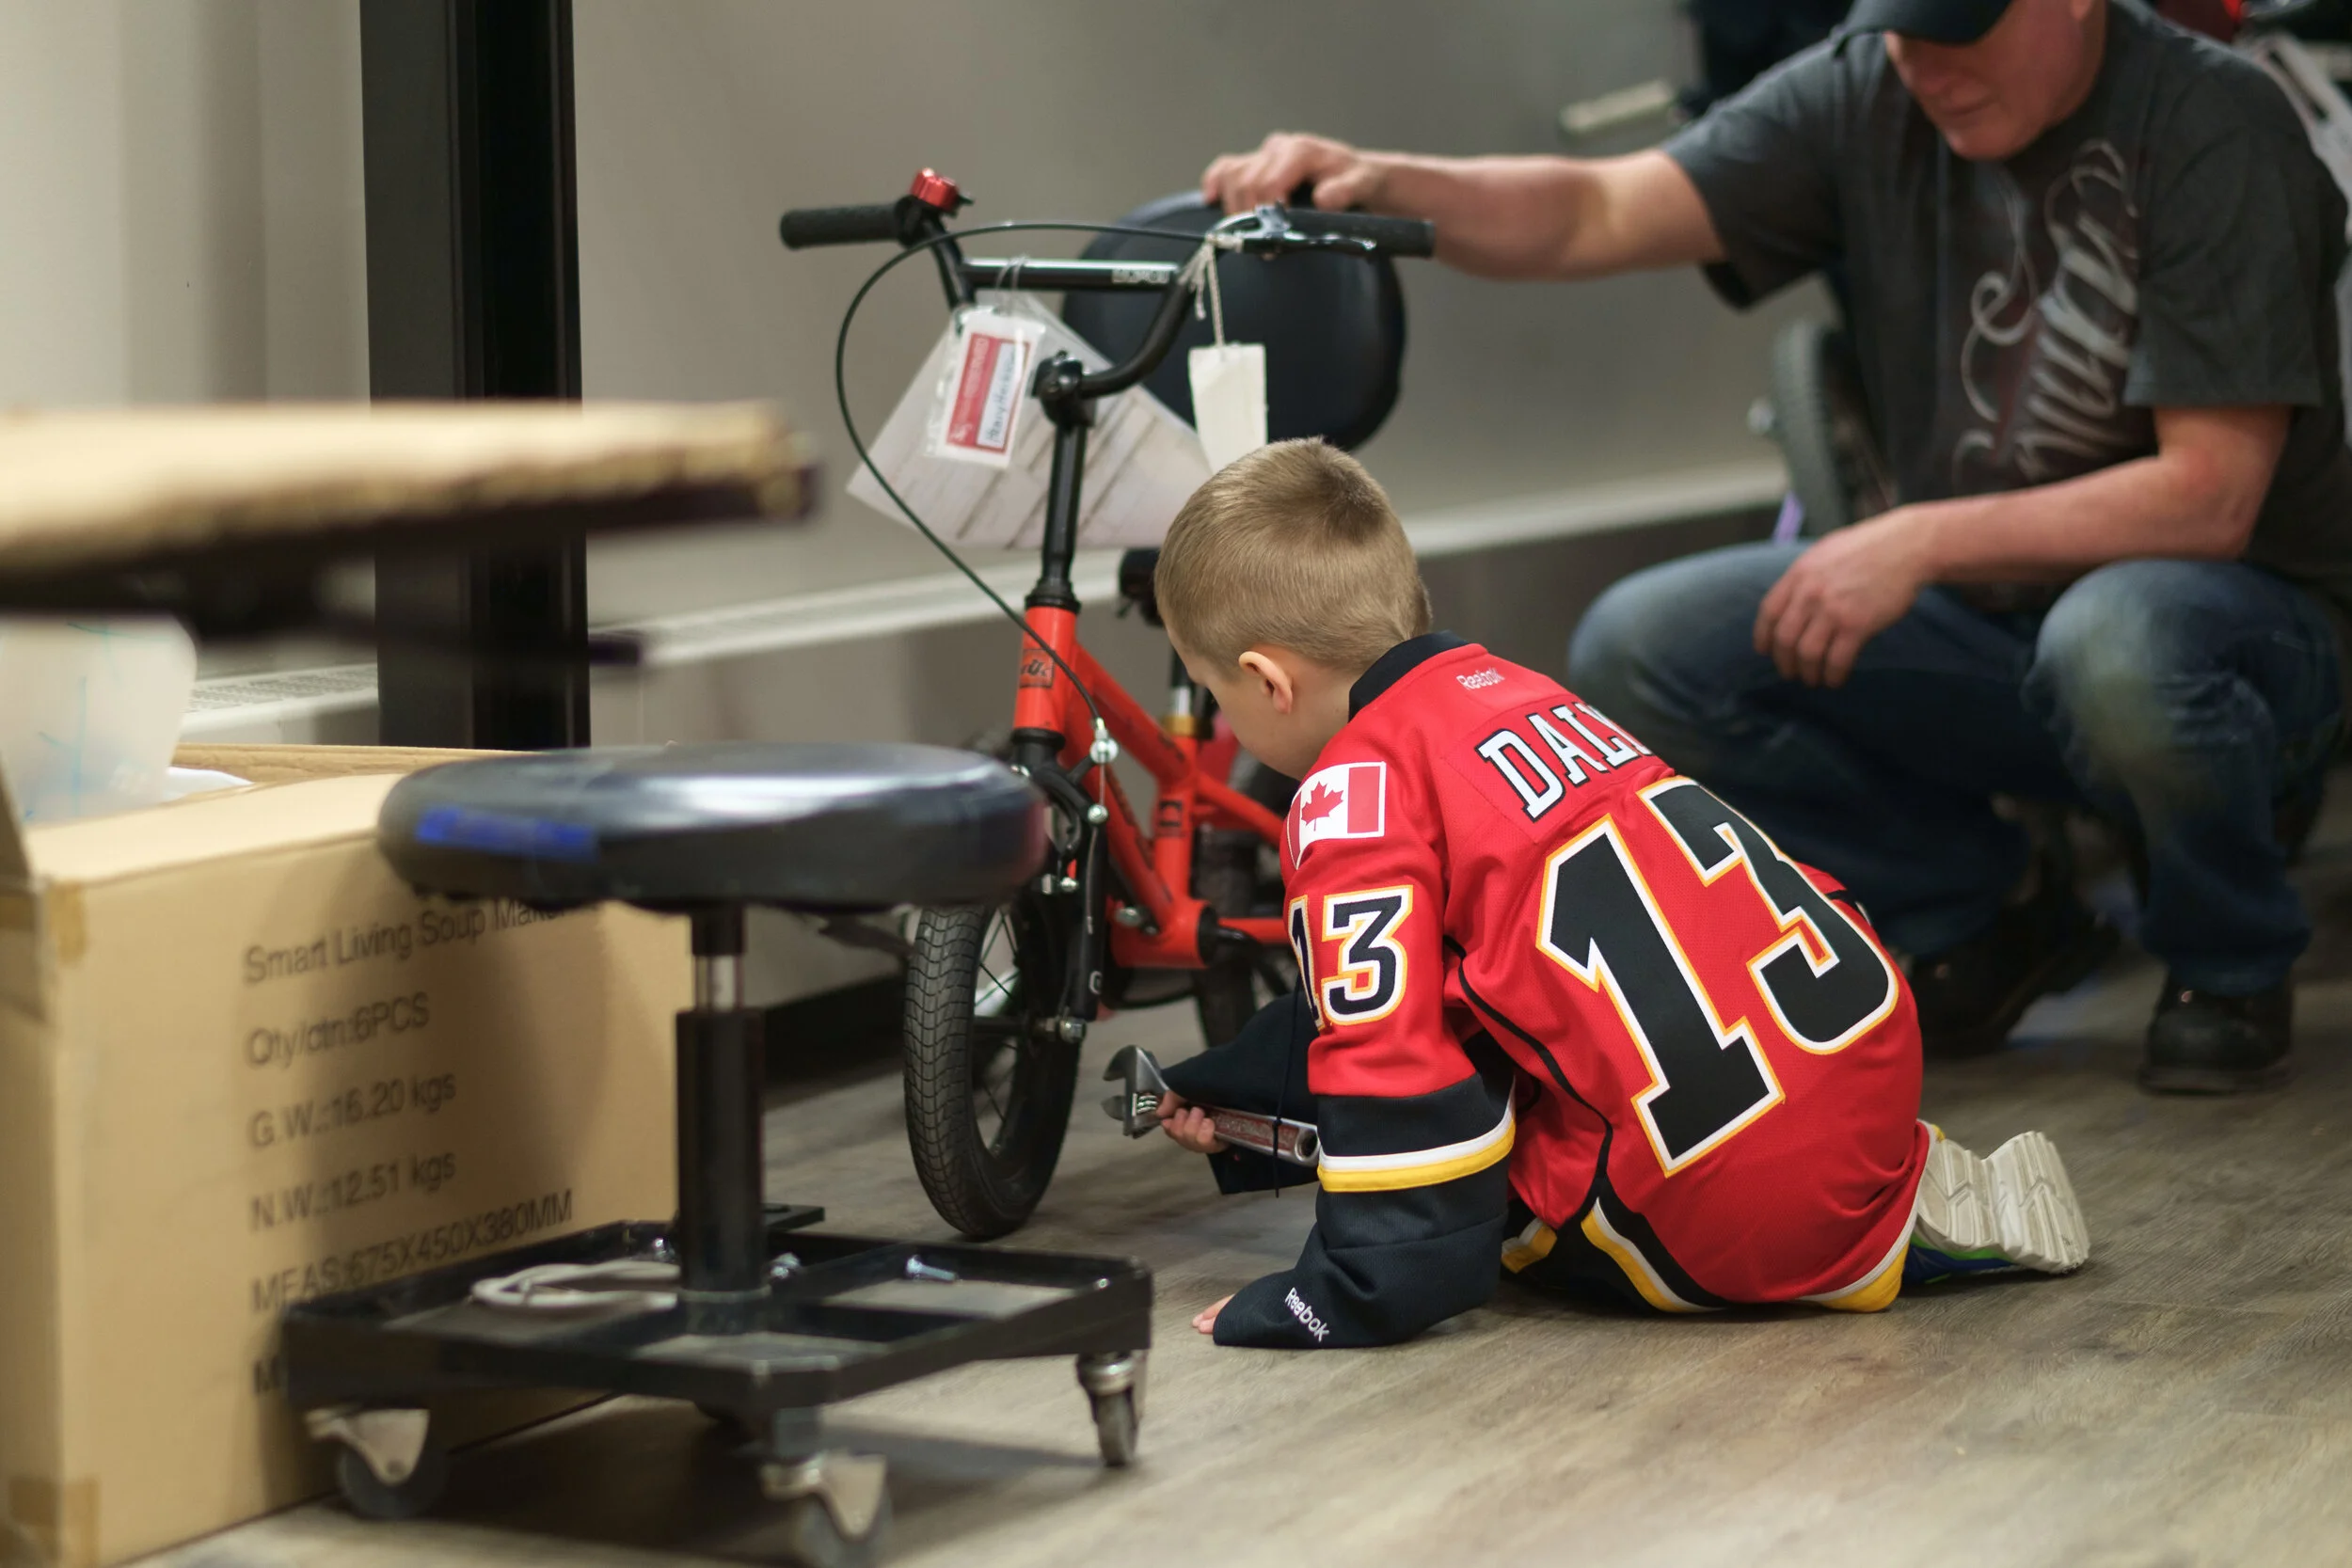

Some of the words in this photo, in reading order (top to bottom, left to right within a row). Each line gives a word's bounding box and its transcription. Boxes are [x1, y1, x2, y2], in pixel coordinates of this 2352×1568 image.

[1456, 667, 1505, 690] Reebok
[246, 944, 328, 984] Smart
[336, 921, 413, 966] Living
[421, 906, 486, 947] Soup
[1288, 884, 1414, 1032] 13
[1536, 775, 1899, 1179] 13
[410, 1073, 457, 1115] kgs
[410, 1152, 457, 1195] kgs
[1284, 1287, 1330, 1343] Reebok
